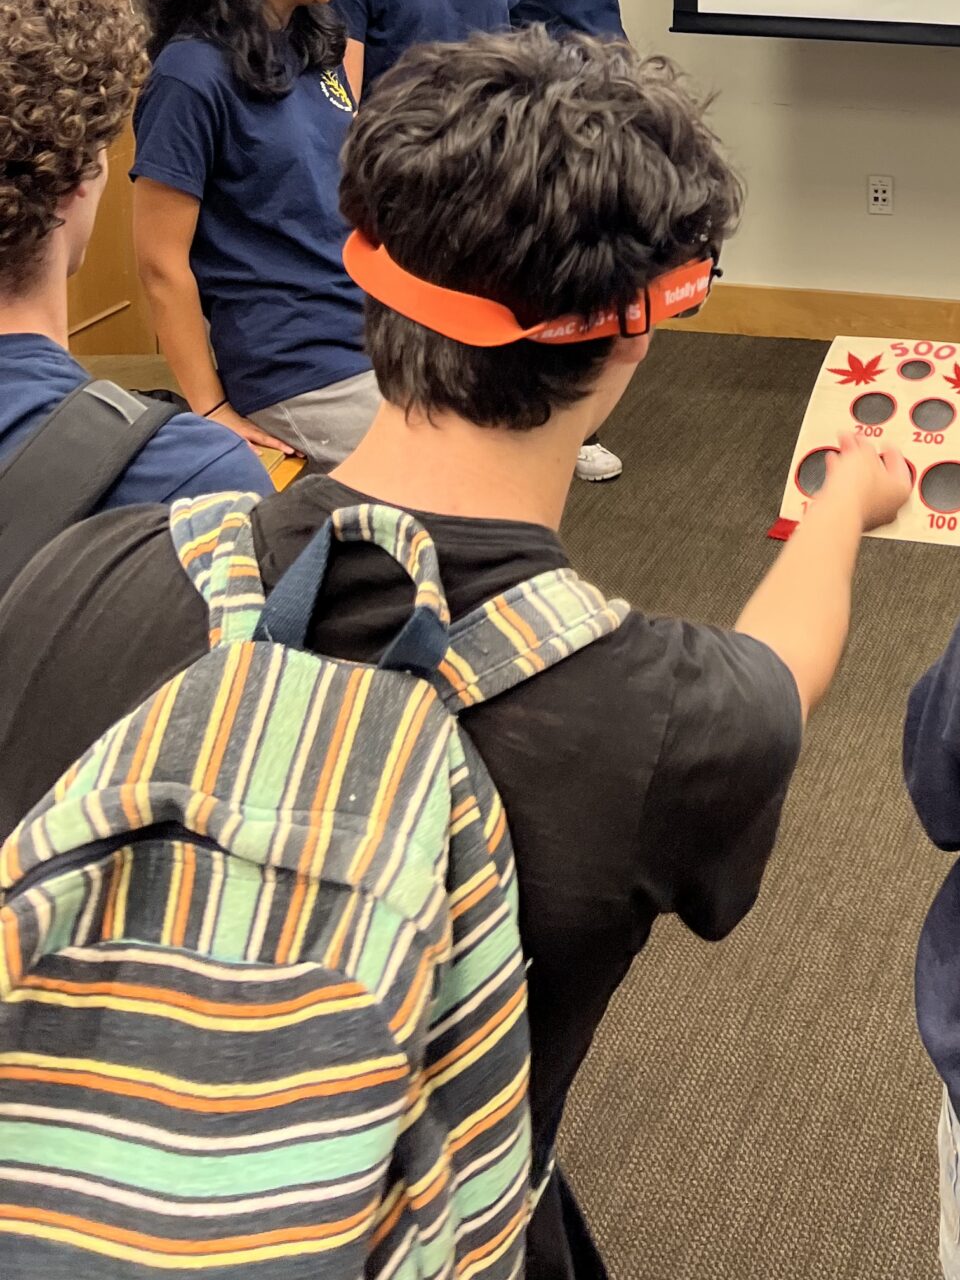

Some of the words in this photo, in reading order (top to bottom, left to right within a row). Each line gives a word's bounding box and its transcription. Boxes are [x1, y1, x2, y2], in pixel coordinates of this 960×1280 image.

[889, 340, 957, 361] 500
[854, 424, 884, 438] 200
[911, 431, 945, 445] 200
[926, 513, 958, 532] 100
